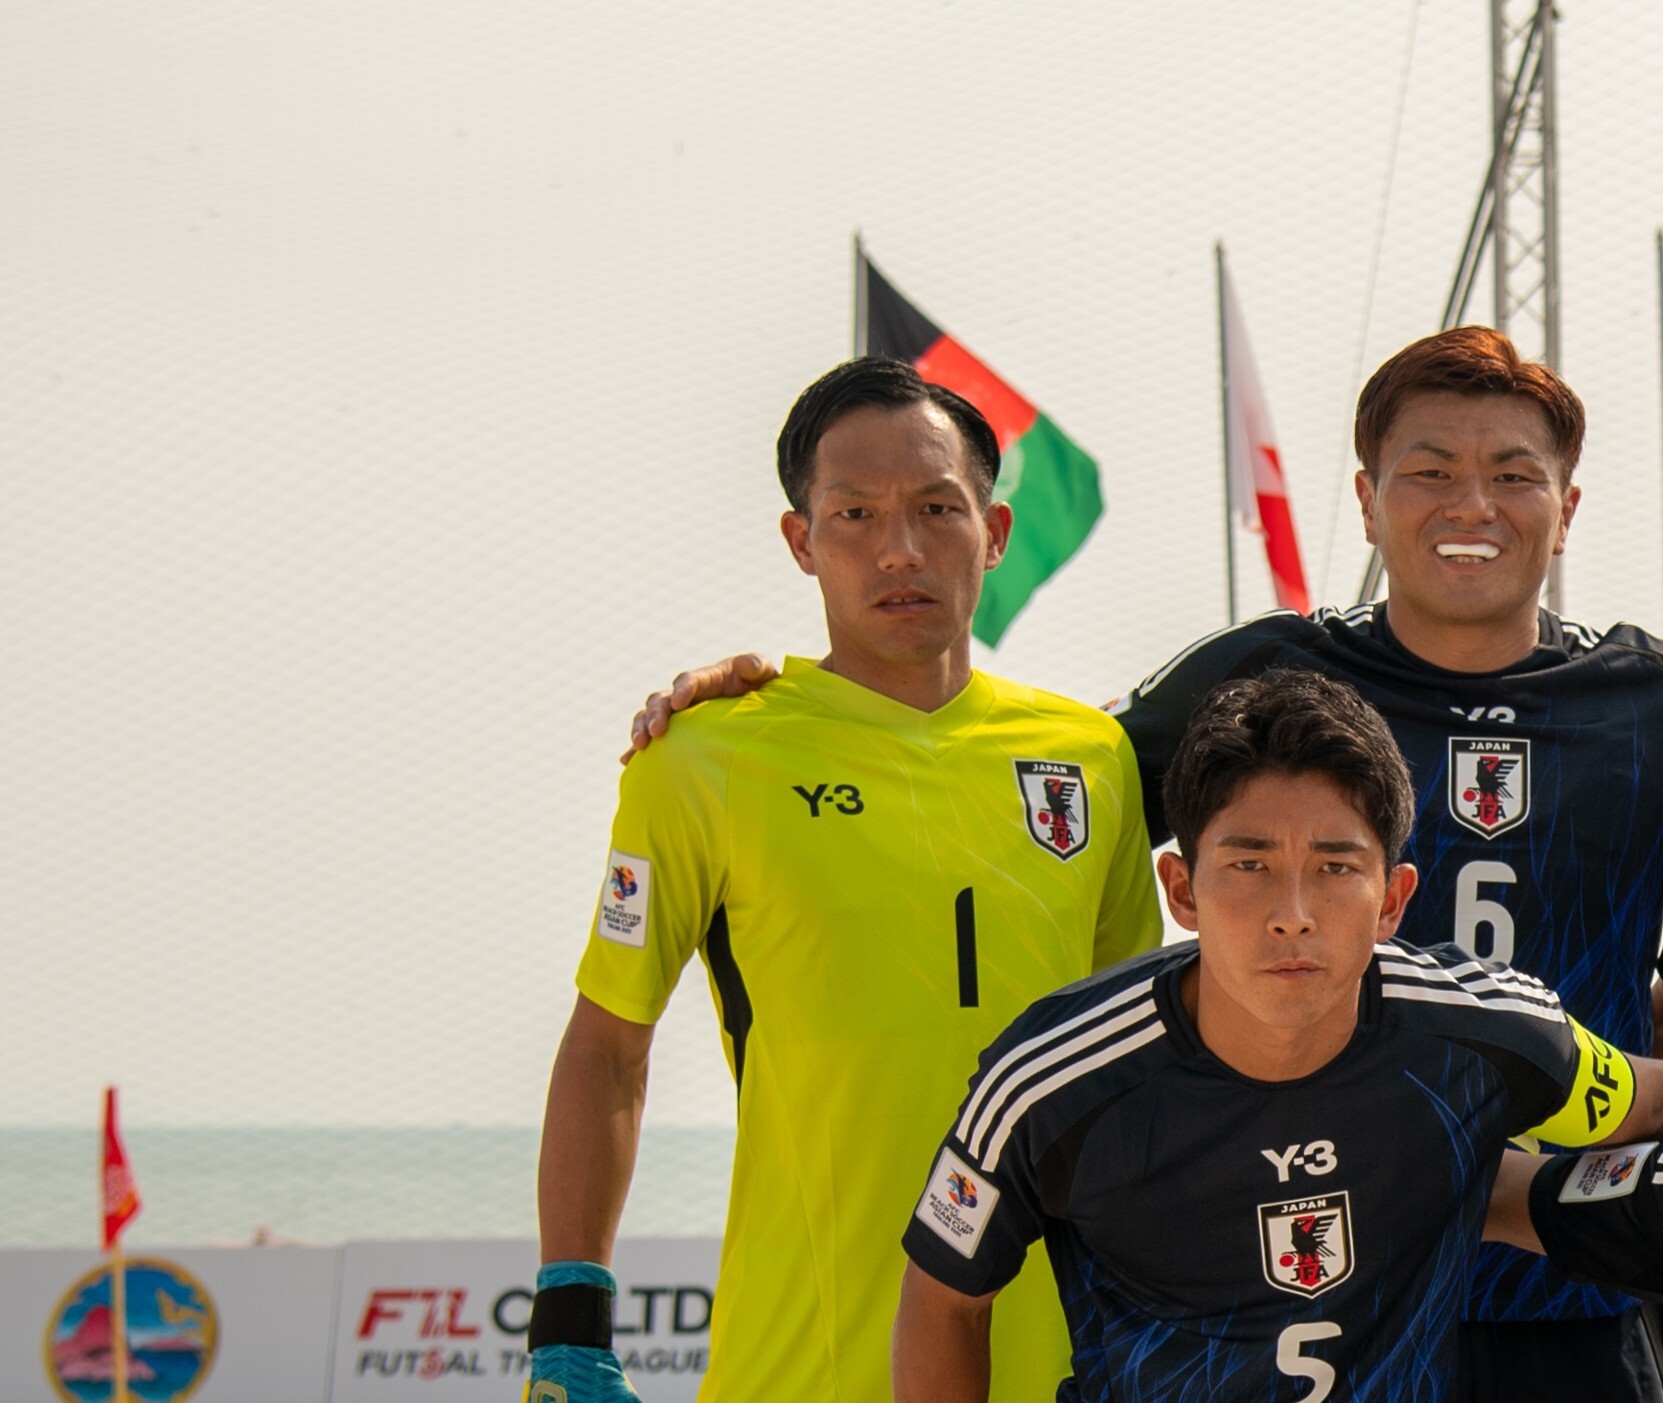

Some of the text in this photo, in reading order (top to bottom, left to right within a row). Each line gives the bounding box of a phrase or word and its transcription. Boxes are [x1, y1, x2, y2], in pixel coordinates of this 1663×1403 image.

[1469, 742, 1511, 751] JAPAN
[1032, 763, 1068, 774] JAPAN
[793, 784, 865, 818] Y-3
[1471, 804, 1507, 819] JFA
[1047, 827, 1076, 844] JFA
[1453, 861, 1517, 963] 6
[955, 887, 979, 1007] 1
[1585, 1031, 1619, 1133] AFC
[1261, 1140, 1337, 1183] Y-3
[1281, 1200, 1327, 1214] JAPAN
[1291, 1264, 1329, 1283] JFA
